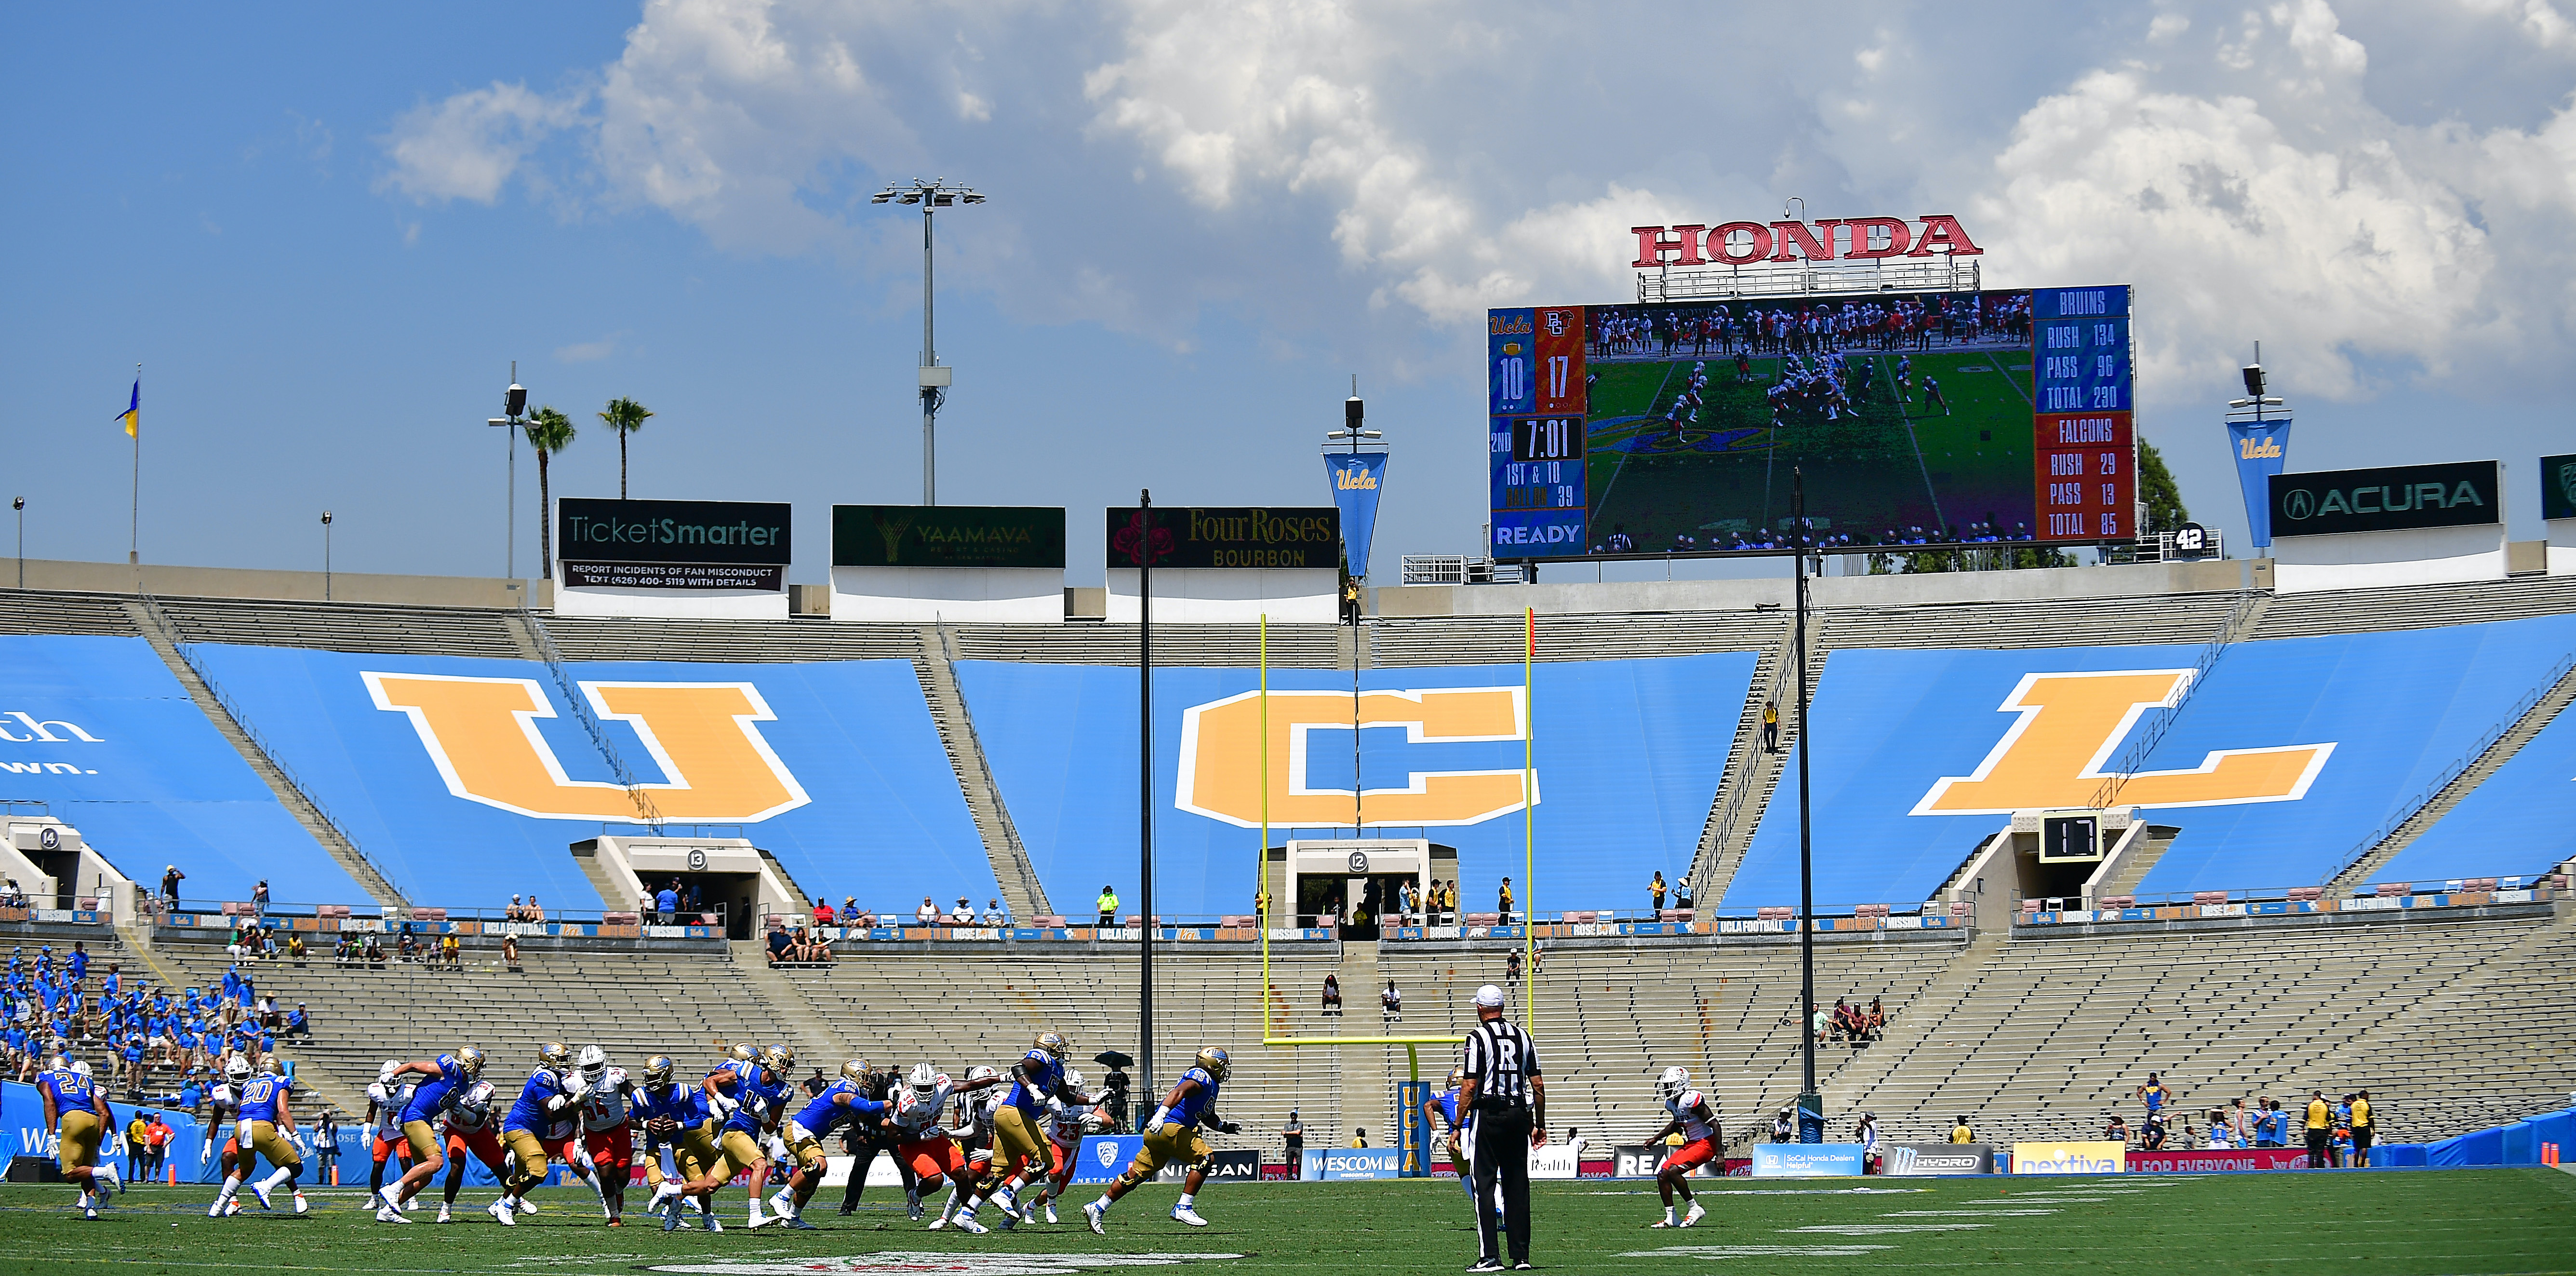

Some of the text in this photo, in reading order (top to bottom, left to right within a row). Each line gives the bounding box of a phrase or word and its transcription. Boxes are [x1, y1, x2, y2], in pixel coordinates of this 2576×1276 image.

[1631, 215, 1984, 268] HONDA
[2059, 291, 2105, 316] BRUINS
[1490, 315, 1532, 335] Ucla
[2047, 323, 2115, 349] RUSH 134
[2046, 354, 2113, 378] PASS 96
[1500, 357, 1523, 400] 10
[1548, 356, 1568, 398] 17
[2047, 386, 2117, 409] TOTAL 230
[1527, 419, 1568, 458] 7:01
[2059, 418, 2112, 443] FALCONS
[1491, 432, 1511, 453] 2ND
[2240, 437, 2282, 460] Ucla
[1506, 461, 1560, 485] 1ST & 10
[2051, 452, 2116, 476] RUSH 29
[1335, 469, 1378, 490] Ucla
[1506, 487, 1531, 507] BALL
[1558, 485, 1574, 507] 39
[2050, 482, 2114, 505] PASS 13
[2317, 480, 2484, 516] ACURA
[570, 516, 779, 546] TicketSmarter
[1188, 509, 1330, 544] Four Roses
[2049, 512, 2117, 536] TOTAL 85
[1496, 525, 1581, 545] READY
[2176, 529, 2202, 550] 42
[1214, 550, 1305, 566] BOURBON
[573, 565, 611, 574] REPORT
[614, 566, 666, 575] INCIDENTS
[708, 568, 773, 577] MISCONDUCT
[611, 577, 637, 585] (626)
[360, 668, 2338, 829] U C L
[44, 832, 55, 844] 14
[2062, 819, 2093, 853] 17
[691, 854, 702, 865] 13
[1352, 856, 1363, 867] 12
[484, 923, 507, 935] UCLA
[508, 923, 547, 935] FOOTBALL
[1429, 927, 1460, 939] BRUINS
[1574, 924, 1595, 936] ROSE
[1597, 924, 1621, 936] BOWL
[1721, 921, 1742, 932] UCLA
[1743, 920, 1784, 932] FOOTBALL
[1887, 917, 1921, 928] MISSION
[953, 928, 974, 940] ROSE
[976, 928, 1000, 940] BOWL
[1100, 928, 1121, 940] UCLA
[1269, 928, 1303, 940] MISSION
[1497, 1039, 1518, 1071] R
[54, 1072, 92, 1097] 24
[1192, 1070, 1205, 1082] 59
[240, 1080, 273, 1107] 20
[904, 1094, 915, 1105] 38
[1057, 1123, 1081, 1141] 23
[1402, 1086, 1422, 1172] UCLA
[1097, 1142, 1119, 1157] PAC
[1104, 1155, 1111, 1164] 12
[1312, 1156, 1383, 1172] WESCOM
[1916, 1158, 1972, 1167] HYDRO
[2022, 1154, 2115, 1173] nextiva
[2142, 1160, 2173, 1172] FOR
[2177, 1158, 2256, 1171] EVERYONE
